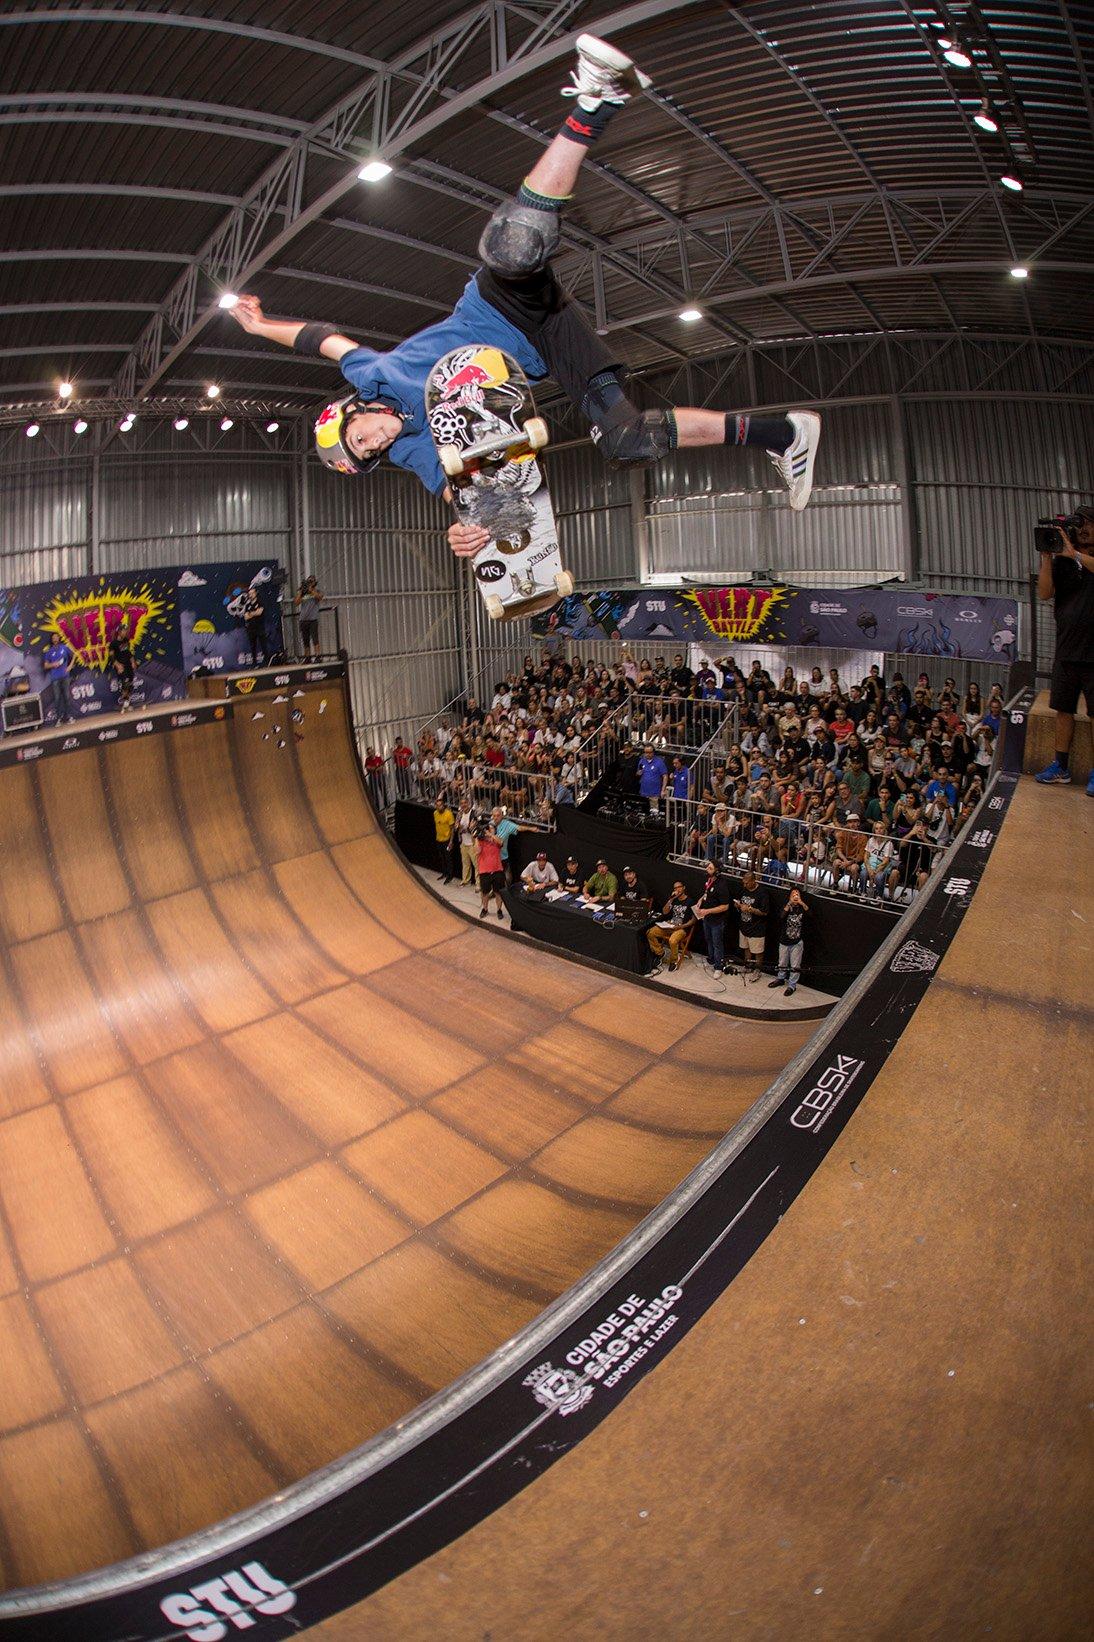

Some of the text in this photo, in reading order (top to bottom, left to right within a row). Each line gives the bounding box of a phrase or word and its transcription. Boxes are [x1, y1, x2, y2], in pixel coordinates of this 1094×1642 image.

[58, 605, 149, 650] VERT
[645, 600, 667, 612] STU
[695, 587, 773, 620] VERT
[71, 682, 96, 700] STU
[943, 876, 971, 896] STU
[790, 1054, 858, 1129] CBSK
[566, 1293, 646, 1366] CIDADE DE
[584, 1285, 683, 1380] SÃO PAULO
[603, 1314, 679, 1388] ESPORTES E LAZER
[159, 1560, 297, 1642] STU
